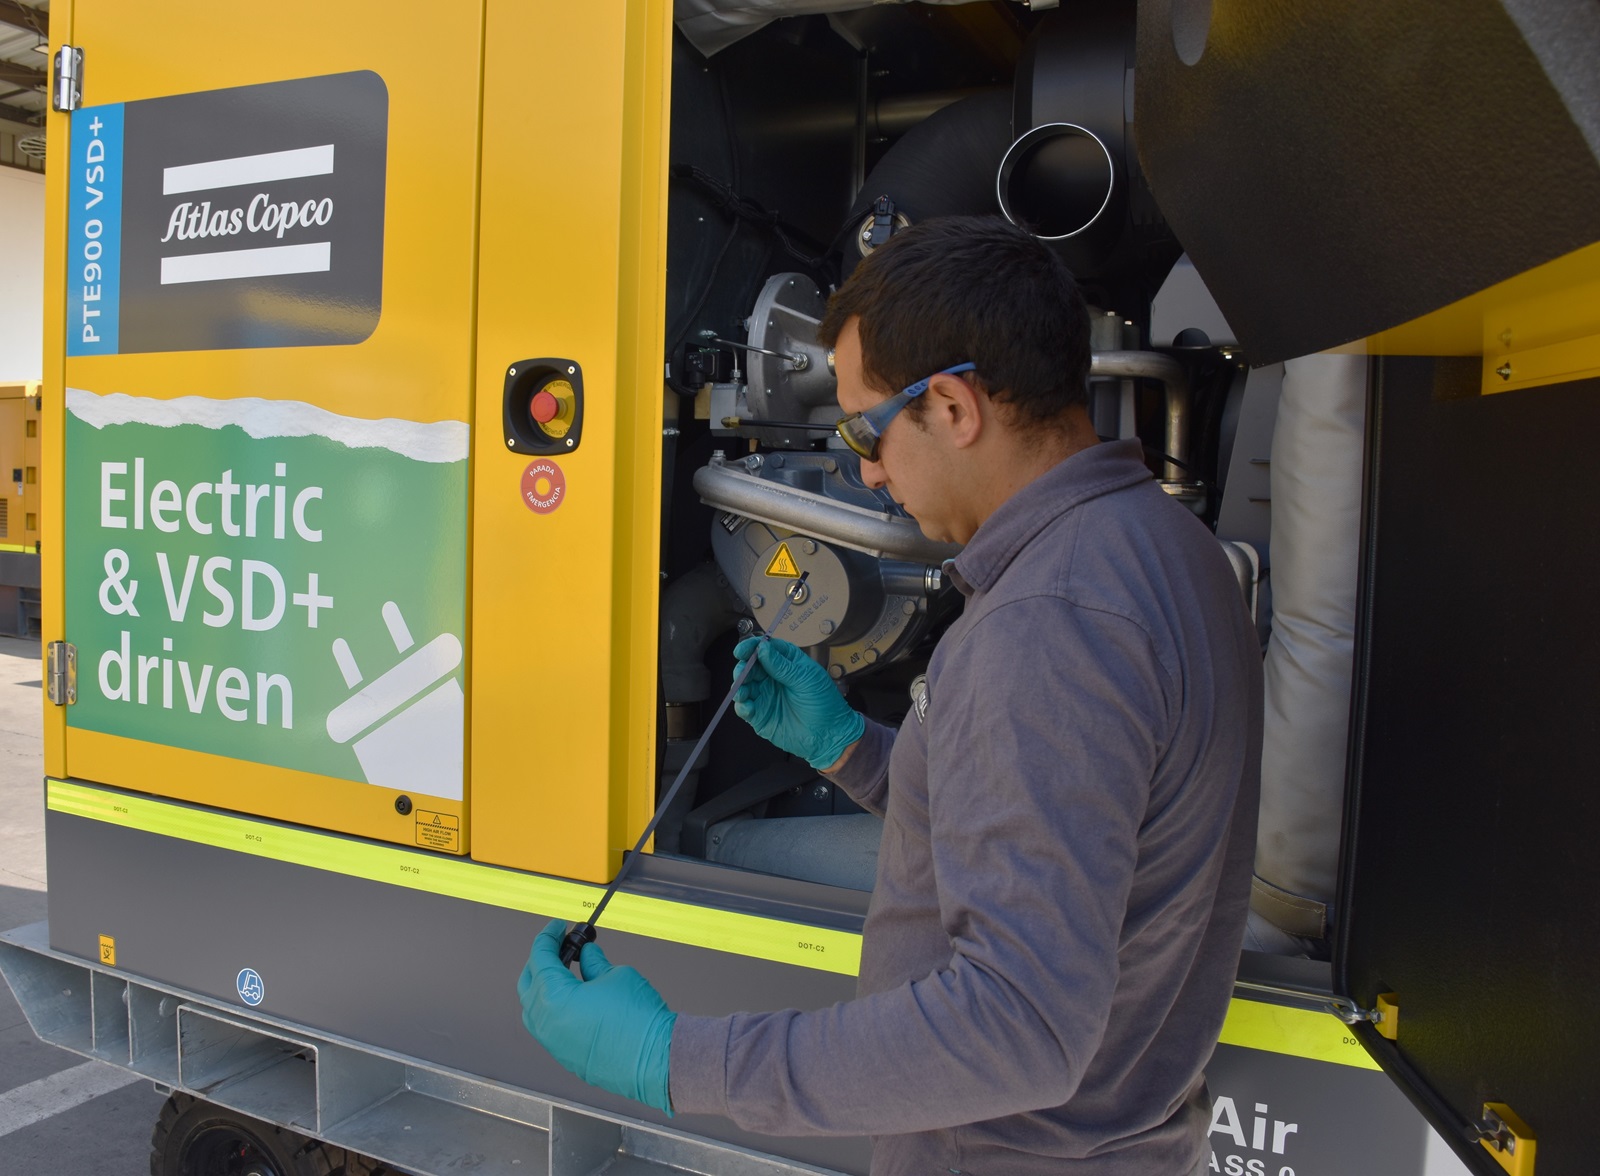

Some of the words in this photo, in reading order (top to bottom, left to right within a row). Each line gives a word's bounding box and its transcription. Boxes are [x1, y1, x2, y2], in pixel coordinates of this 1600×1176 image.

[85, 116, 105, 211] VSD+
[160, 201, 244, 243] Atlas
[246, 193, 334, 239] Copco
[82, 219, 103, 343] PTE900
[529, 465, 555, 477] PARADA
[100, 457, 323, 542] Electric
[526, 486, 561, 508] EMERGENCIA
[98, 548, 140, 618] &
[156, 552, 334, 632] VSD+
[98, 631, 293, 730] driven
[245, 833, 262, 842] DOT-C2
[399, 864, 420, 874] DOT-C2
[582, 901, 598, 910] DOT-
[798, 941, 825, 953] DOT-C2
[1342, 1036, 1361, 1046] DO
[1206, 1095, 1298, 1155] Air
